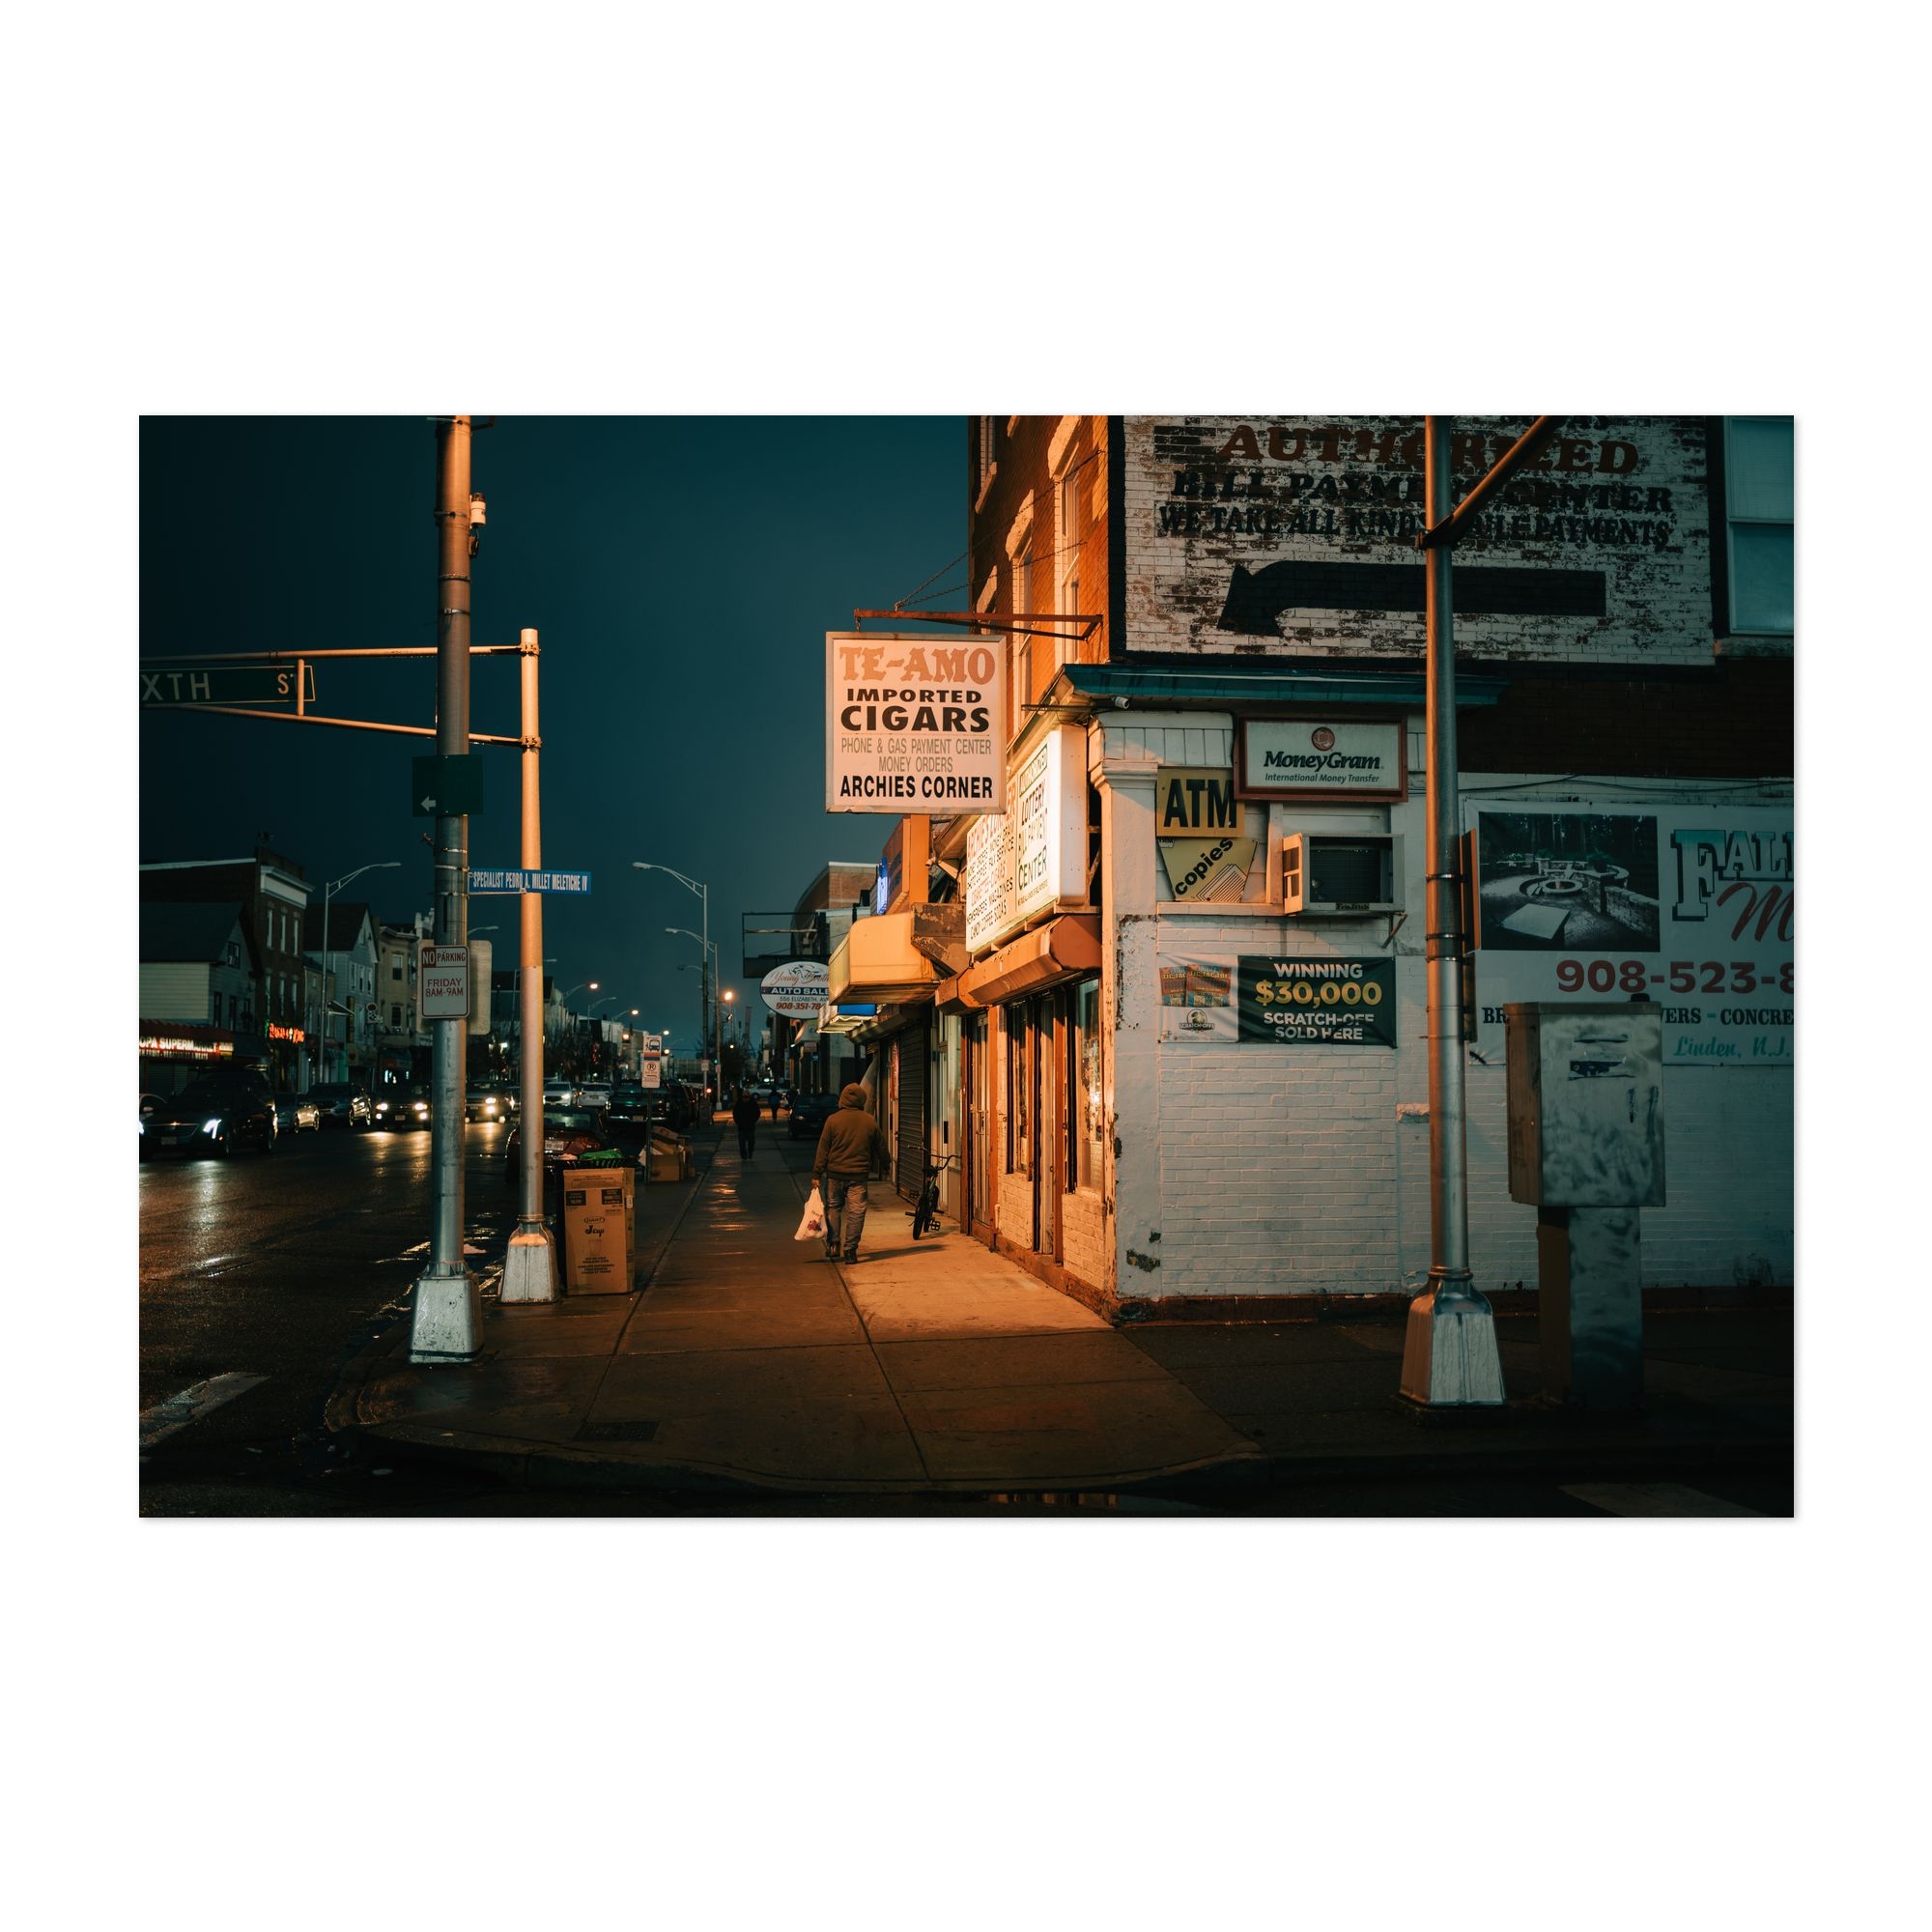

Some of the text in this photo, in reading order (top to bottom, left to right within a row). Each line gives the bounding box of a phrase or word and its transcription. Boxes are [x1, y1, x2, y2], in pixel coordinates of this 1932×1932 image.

[839, 646, 996, 685] TE-AMO
[141, 672, 211, 701] XTH
[847, 688, 982, 703] IMPORTED
[840, 705, 990, 732] CIGARS
[841, 737, 992, 754] PHONE & GAS PAYMENT CENTER
[878, 756, 953, 773] MONEY ORDERS
[1264, 751, 1380, 773] MoneyGram
[1264, 773, 1380, 784] International Money Transfer
[839, 776, 993, 799] ARCHIES CORNER
[1163, 779, 1237, 829] ATM
[1018, 842, 1047, 893] CENTER
[1175, 838, 1234, 895] copies
[473, 871, 503, 888] SPECIALIST
[505, 872, 523, 889] PEDRO
[532, 873, 551, 889] MILLET
[422, 951, 466, 965] NO PARKING
[1274, 963, 1364, 979] WINNING
[427, 978, 463, 987] FRIDAY
[426, 987, 464, 997] 8AM-9AM
[1255, 979, 1383, 1009] $30,000
[776, 1002, 824, 1010] 908-351-78
[1275, 1026, 1364, 1040] SOLD HERE
